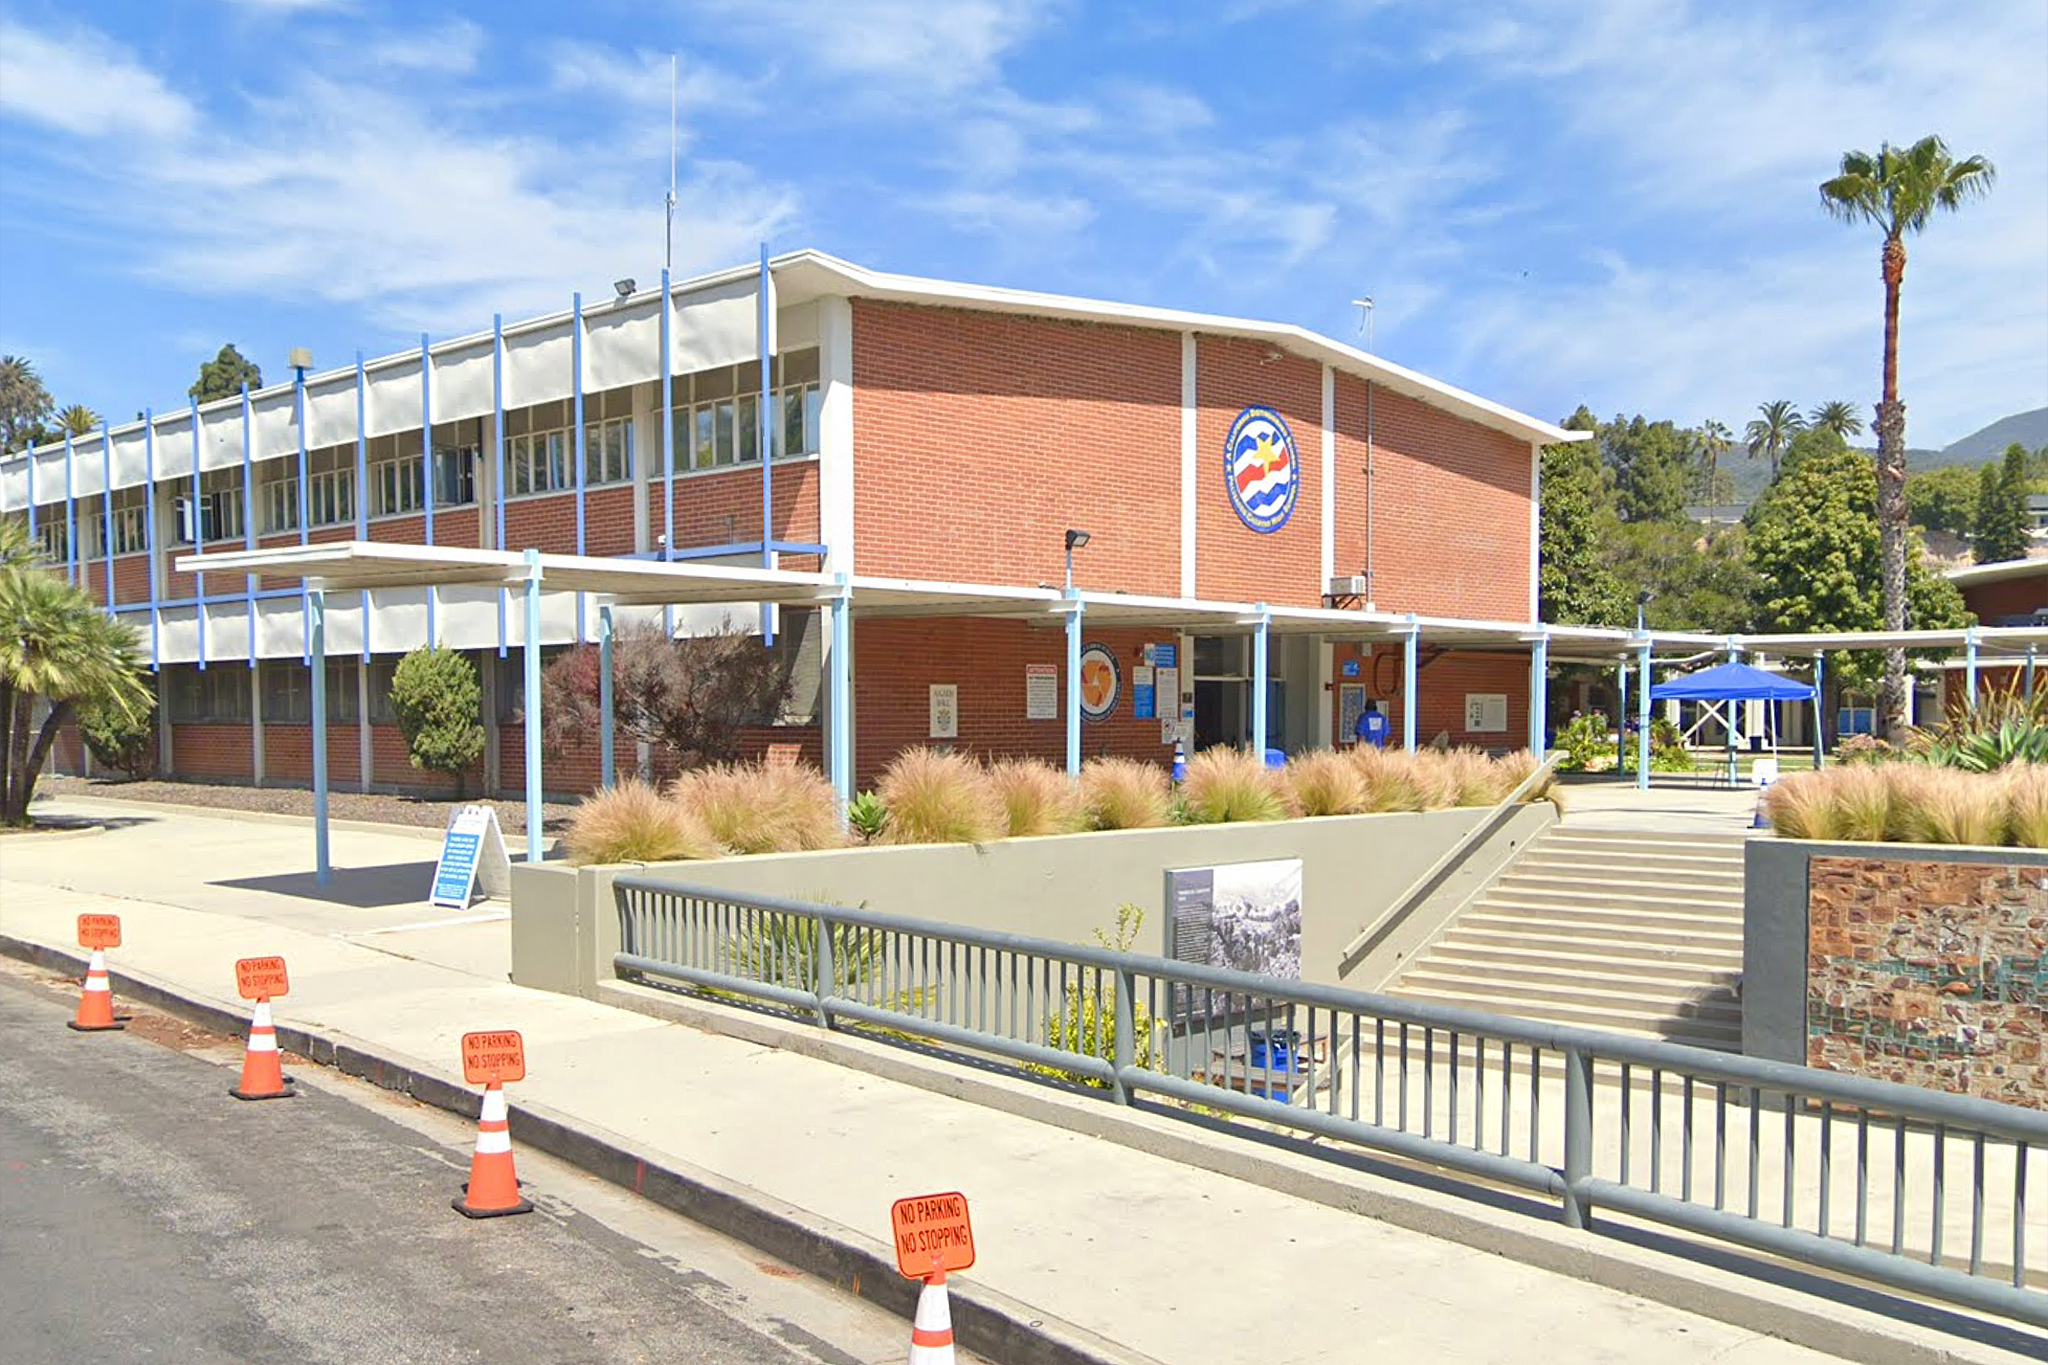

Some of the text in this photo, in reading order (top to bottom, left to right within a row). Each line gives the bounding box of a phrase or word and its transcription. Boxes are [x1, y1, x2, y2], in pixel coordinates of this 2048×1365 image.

[240, 959, 280, 973] NO PARKING
[240, 973, 284, 987] NO STOPPING
[468, 1034, 517, 1050] NO PARKING
[468, 1053, 520, 1069] NO STOPPING
[899, 1196, 961, 1226] NO PARKING
[901, 1225, 968, 1255] NO STOPPING
